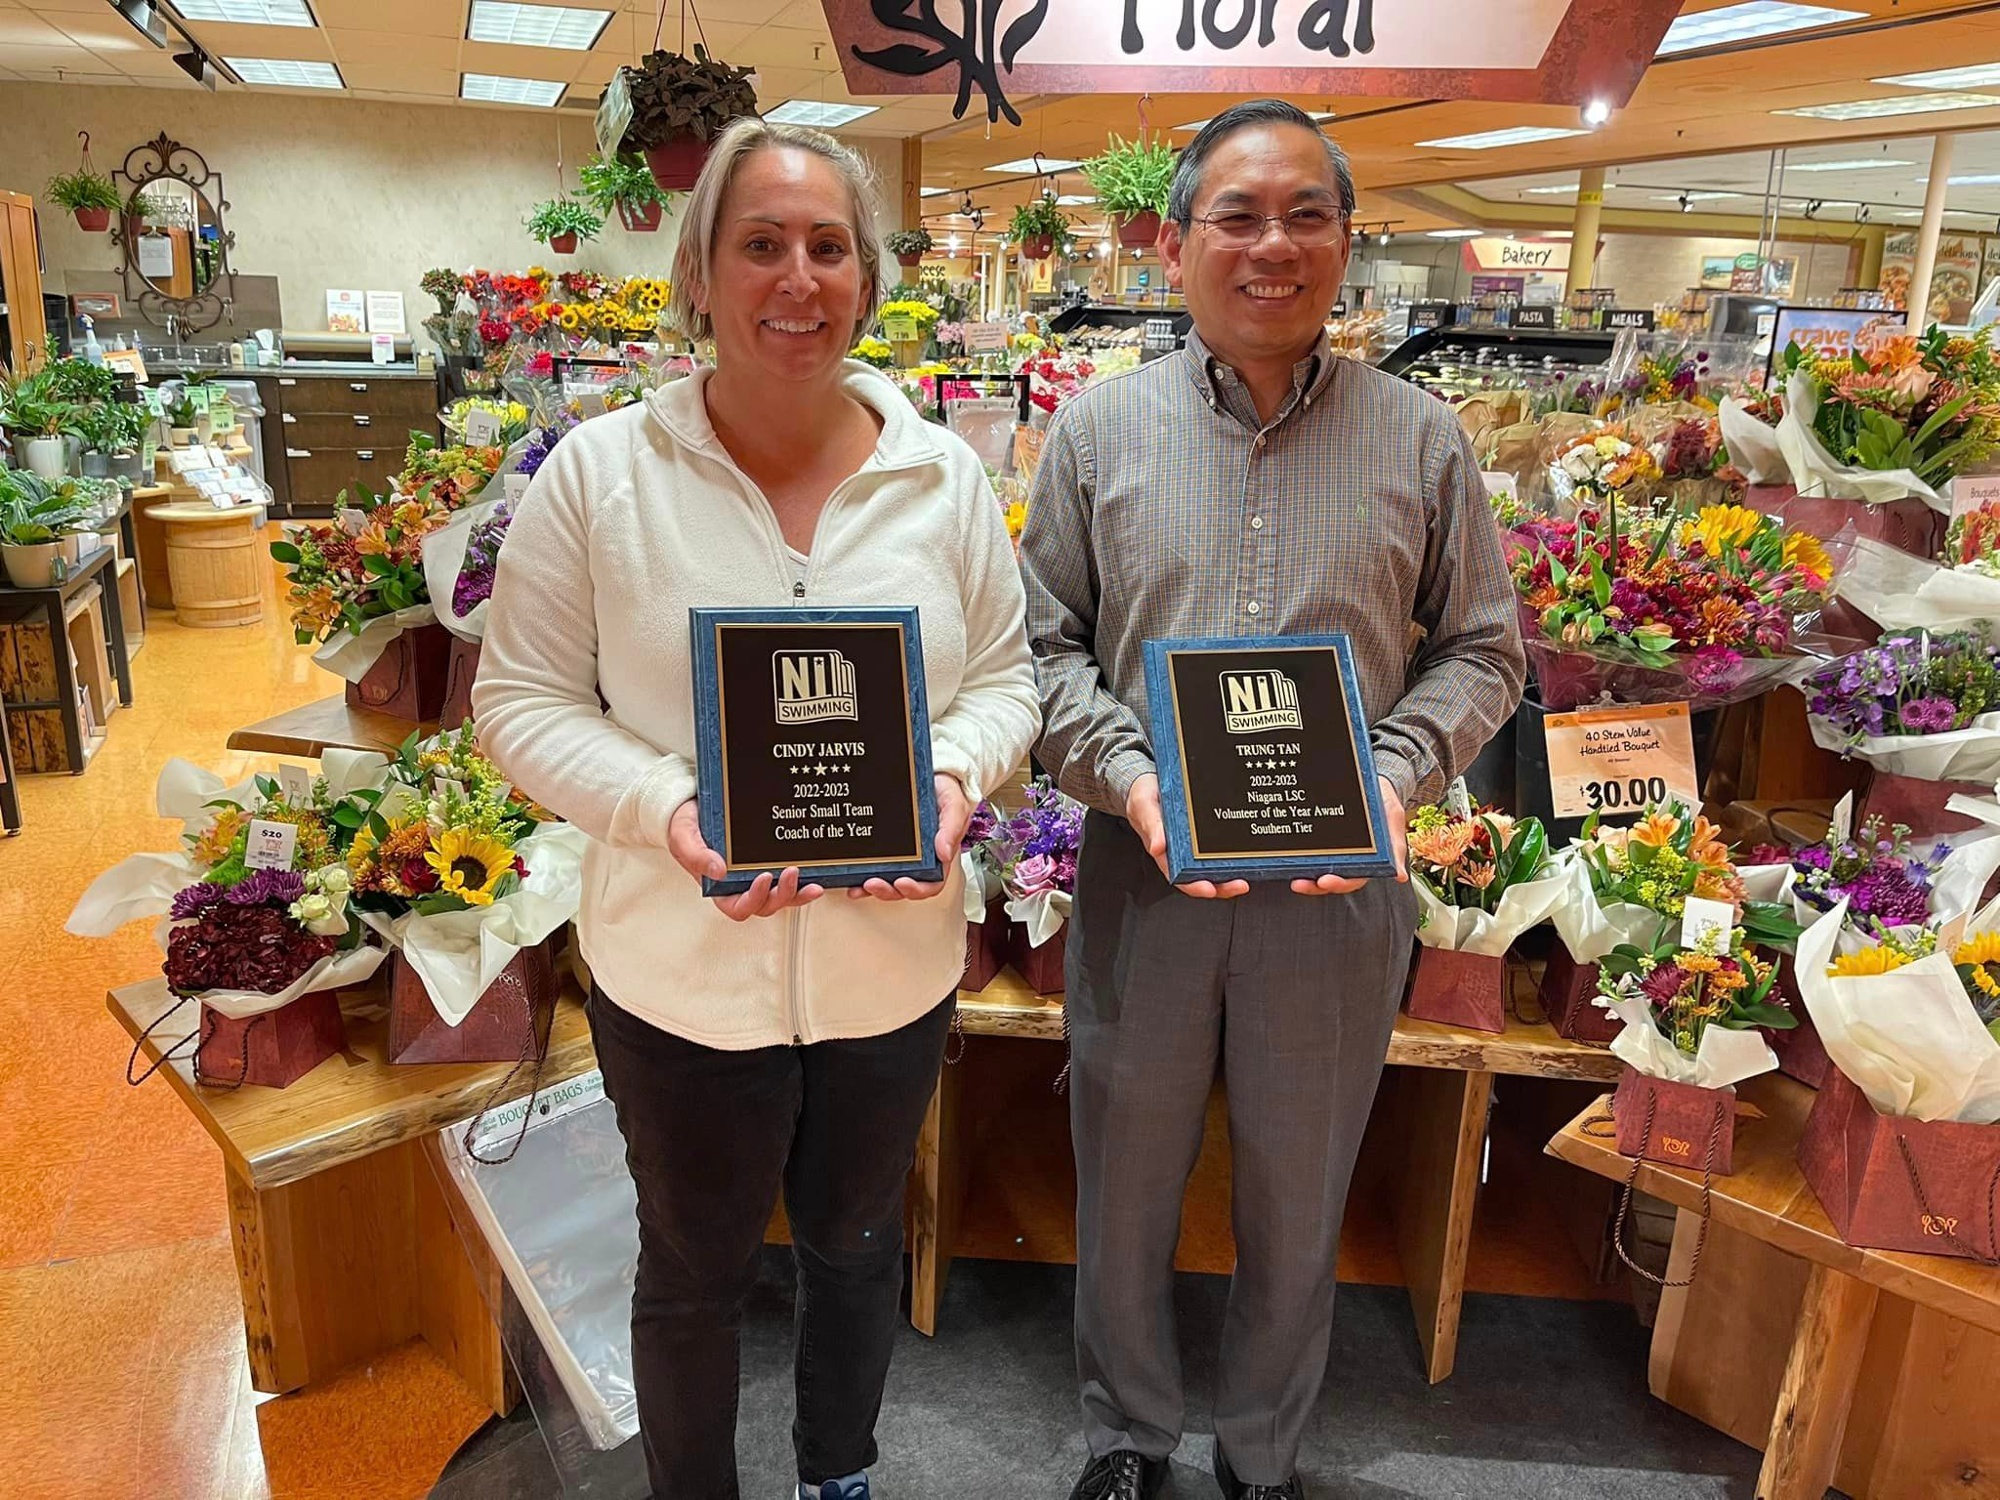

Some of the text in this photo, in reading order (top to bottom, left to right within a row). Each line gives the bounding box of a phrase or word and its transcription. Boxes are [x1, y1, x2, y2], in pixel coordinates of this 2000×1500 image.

[1502, 246, 1552, 266] Bakery
[1519, 311, 1544, 324] PASTA
[1611, 313, 1644, 327] MEALS
[1788, 327, 1851, 346] crave
[1970, 486, 2000, 499] Bouquets
[781, 700, 852, 719] SWIMMING
[1231, 711, 1296, 728] SWIMMING
[1585, 727, 1652, 742] 40 Stem Value
[773, 742, 865, 758] CINDY JARVIS
[1236, 743, 1301, 756] TRUNG TAN
[1580, 740, 1660, 757] Handtied Bouquet
[1250, 775, 1297, 787] 2022-2023
[793, 783, 850, 798] 2022-2023
[1247, 789, 1306, 805] Niagara LSC
[1579, 777, 1666, 810] $30.00
[772, 802, 873, 819] Senior Small Team
[1214, 805, 1344, 819] Volunteer of the Year Award
[775, 822, 873, 840] Coach of the Year
[1250, 822, 1313, 835] Southern Tier
[498, 1095, 551, 1126] BOUQUET
[553, 1083, 583, 1105] BAGS
